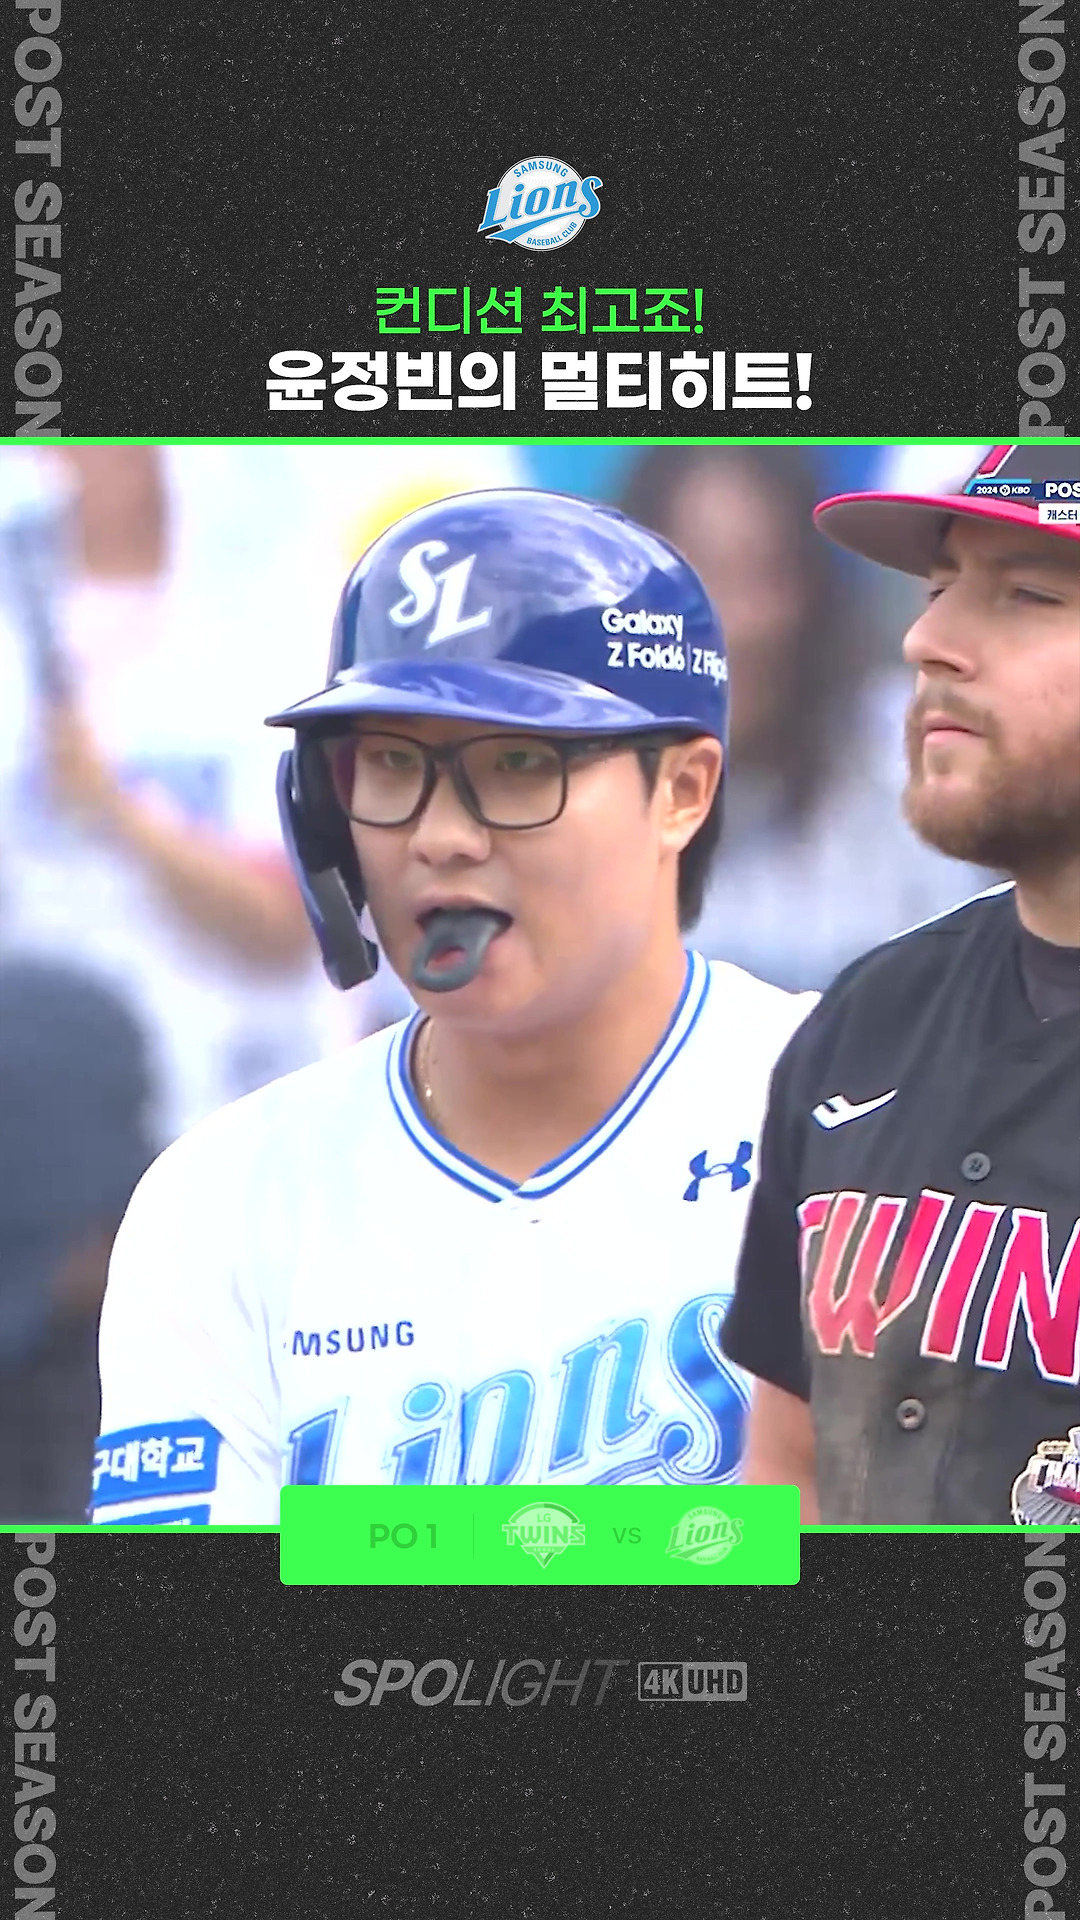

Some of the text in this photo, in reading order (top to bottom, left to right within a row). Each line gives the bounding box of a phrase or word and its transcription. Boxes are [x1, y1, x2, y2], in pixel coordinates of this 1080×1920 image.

[601, 607, 684, 642] Galaxy
[606, 641, 625, 668] Z
[627, 642, 686, 672] Fold6
[692, 648, 703, 675] Z
[283, 1320, 416, 1357] MSUNG
